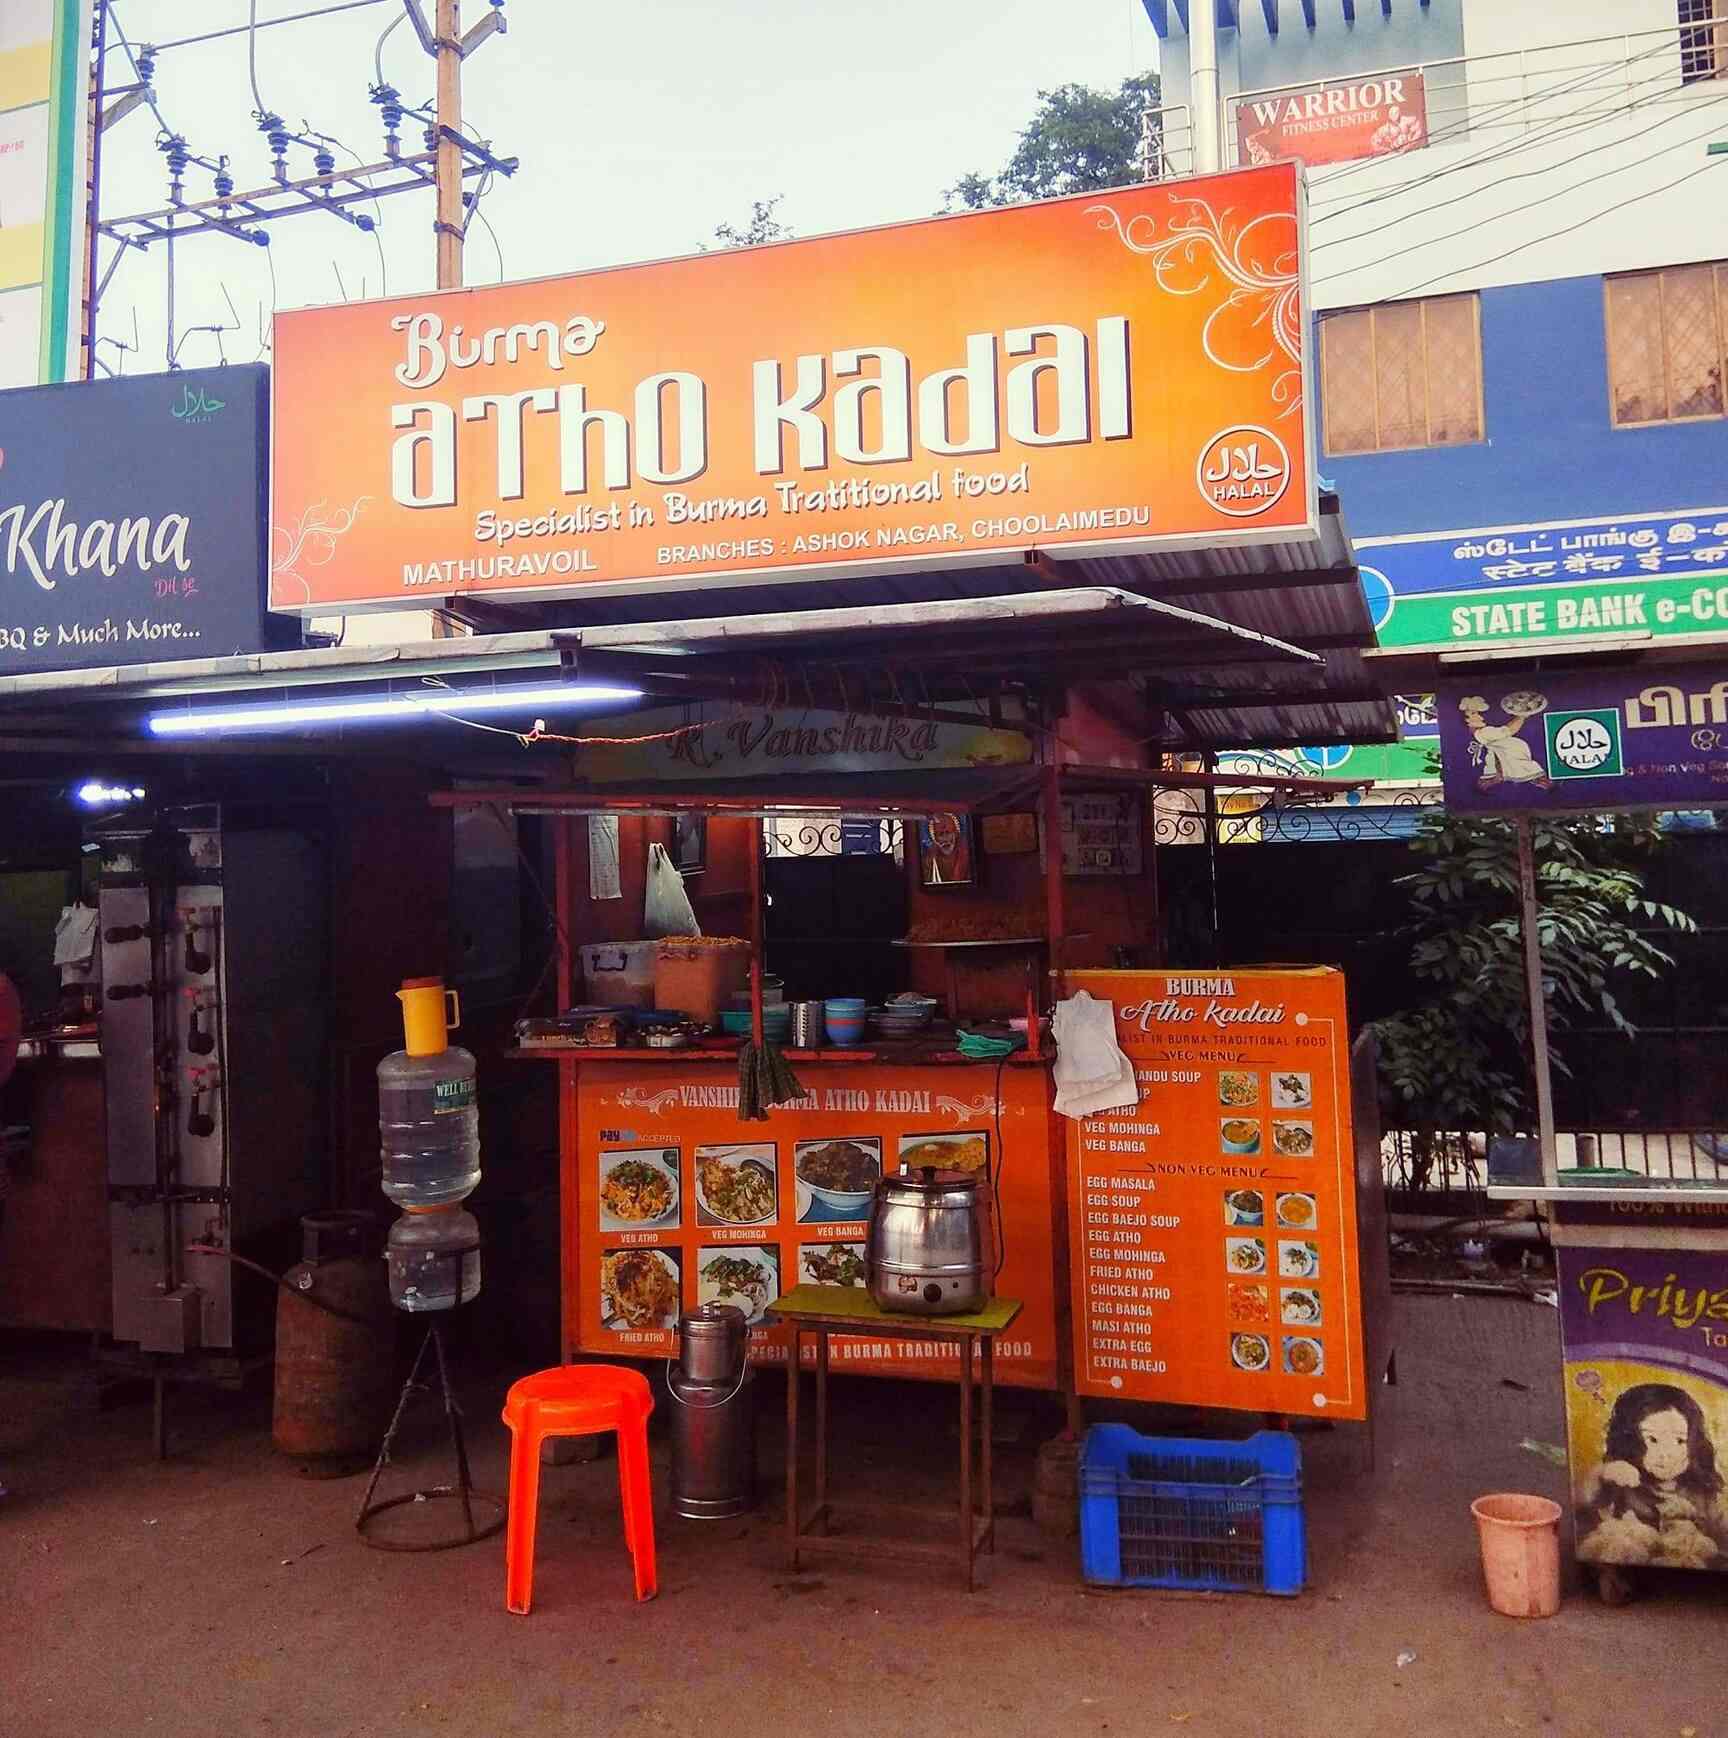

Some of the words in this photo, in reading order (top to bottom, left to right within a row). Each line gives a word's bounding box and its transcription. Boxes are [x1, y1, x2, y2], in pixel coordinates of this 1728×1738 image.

[1252, 79, 1406, 127] WARRIOR
[1282, 119, 1329, 137] FITNESS
[1331, 111, 1378, 129] CENTER
[391, 312, 606, 389] Burma
[172, 384, 226, 418] حلال
[1203, 442, 1284, 483] حلال
[1212, 483, 1277, 501] HALAL
[474, 509, 622, 546] Specialist
[629, 504, 655, 530] in
[663, 491, 768, 525] Burma
[774, 471, 942, 515] Tratitional
[952, 463, 1030, 498] food
[656, 537, 774, 565] BRANCHES
[793, 528, 871, 555] ASHOK
[876, 522, 966, 547] NAGAR,
[971, 505, 1152, 538] CHOOLAIMEDU
[0, 498, 191, 590] Khana
[403, 549, 598, 587] MATHURAVOIL
[1452, 601, 1547, 636] STATE
[1557, 593, 1648, 629] BANK
[33, 625, 50, 647] &
[58, 619, 119, 646] Much
[127, 617, 200, 641] More...
[728, 713, 939, 761] Vanshika
[1560, 729, 1608, 750] حلال
[1165, 977, 1236, 997] BURMA
[1120, 1000, 1198, 1033] Atho
[1151, 1035, 1163, 1045] IN
[1168, 1034, 1208, 1046] BURMA
[1212, 1035, 1288, 1047] TRADITIONAL
[1295, 1037, 1327, 1047] FOOD
[1168, 1051, 1194, 1062] VEG
[1199, 1052, 1237, 1063] MENU
[1171, 1071, 1201, 1083] SOUP
[824, 1090, 869, 1112] ATHO
[875, 1089, 932, 1113] KADAI
[1085, 1122, 1106, 1133] VEG
[1109, 1122, 1161, 1135] MOHINGA
[1085, 1140, 1106, 1151] VEG
[1109, 1141, 1146, 1153] BANGA
[1158, 1163, 1186, 1174] NON
[1190, 1164, 1216, 1176] VEG
[1220, 1166, 1259, 1178] MENU
[1087, 1176, 1108, 1188] EGG
[1111, 1177, 1156, 1191] MASALA
[1087, 1194, 1108, 1206] EGG
[1111, 1195, 1141, 1208] SOUP
[1088, 1212, 1109, 1224] EGG
[1112, 1213, 1147, 1226] BAEJO
[1150, 1214, 1181, 1228] SOUP
[620, 1234, 636, 1243] VEG
[638, 1233, 658, 1243] ATHO
[712, 1230, 728, 1240] VEG
[729, 1229, 767, 1240] MOHINGA
[817, 1226, 836, 1237] VEG
[838, 1226, 865, 1237] BANGA
[1088, 1230, 1110, 1242] EGG
[1112, 1231, 1142, 1244] ATHO
[1089, 1247, 1110, 1260] EGG
[1113, 1249, 1166, 1263] MOHINGA
[1090, 1265, 1121, 1278] FRIED
[1125, 1267, 1154, 1281] ATHO
[1091, 1284, 1138, 1298] CHICKEN
[1142, 1287, 1171, 1300] ATHO
[1092, 1301, 1113, 1314] EGG
[1116, 1303, 1152, 1316] BANGA
[1092, 1319, 1120, 1332] MASI
[1123, 1321, 1152, 1335] ATHO
[620, 1333, 642, 1343] FRIED
[644, 1332, 665, 1343] ATHO
[1093, 1337, 1127, 1350] EXTRA
[1130, 1340, 1152, 1353] EGG
[843, 1343, 892, 1359] BURMA
[994, 1342, 1032, 1358] FOOD
[1093, 1356, 1128, 1369] EXTRA
[1131, 1358, 1167, 1373] BAEJO
